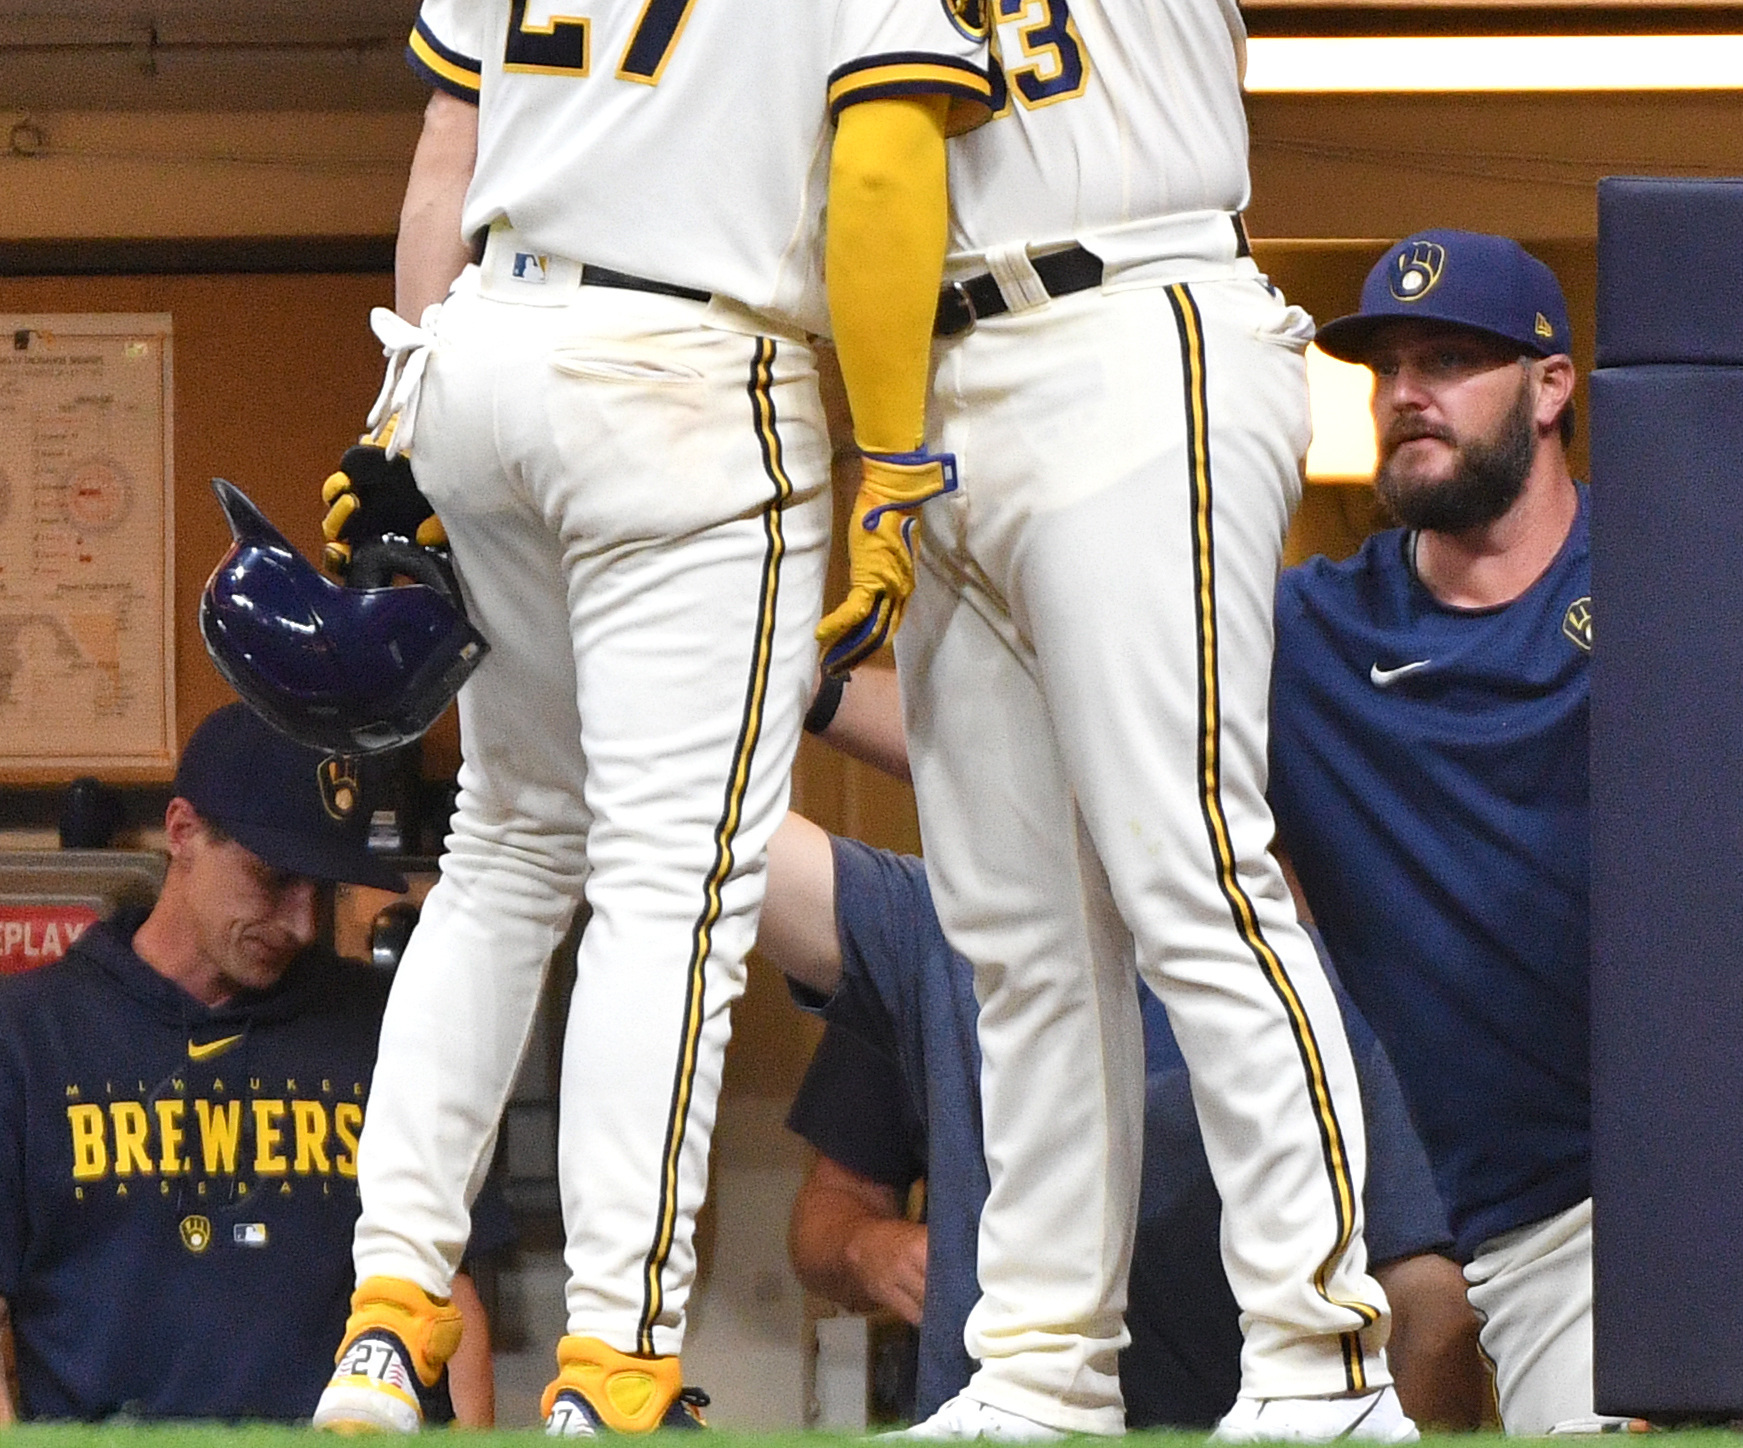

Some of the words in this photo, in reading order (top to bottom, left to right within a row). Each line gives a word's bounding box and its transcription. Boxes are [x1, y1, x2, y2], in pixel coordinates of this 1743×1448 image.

[66, 1078, 362, 1096] MILWAUKEE
[67, 1099, 363, 1178] BREWERS
[351, 1344, 394, 1380] 27
